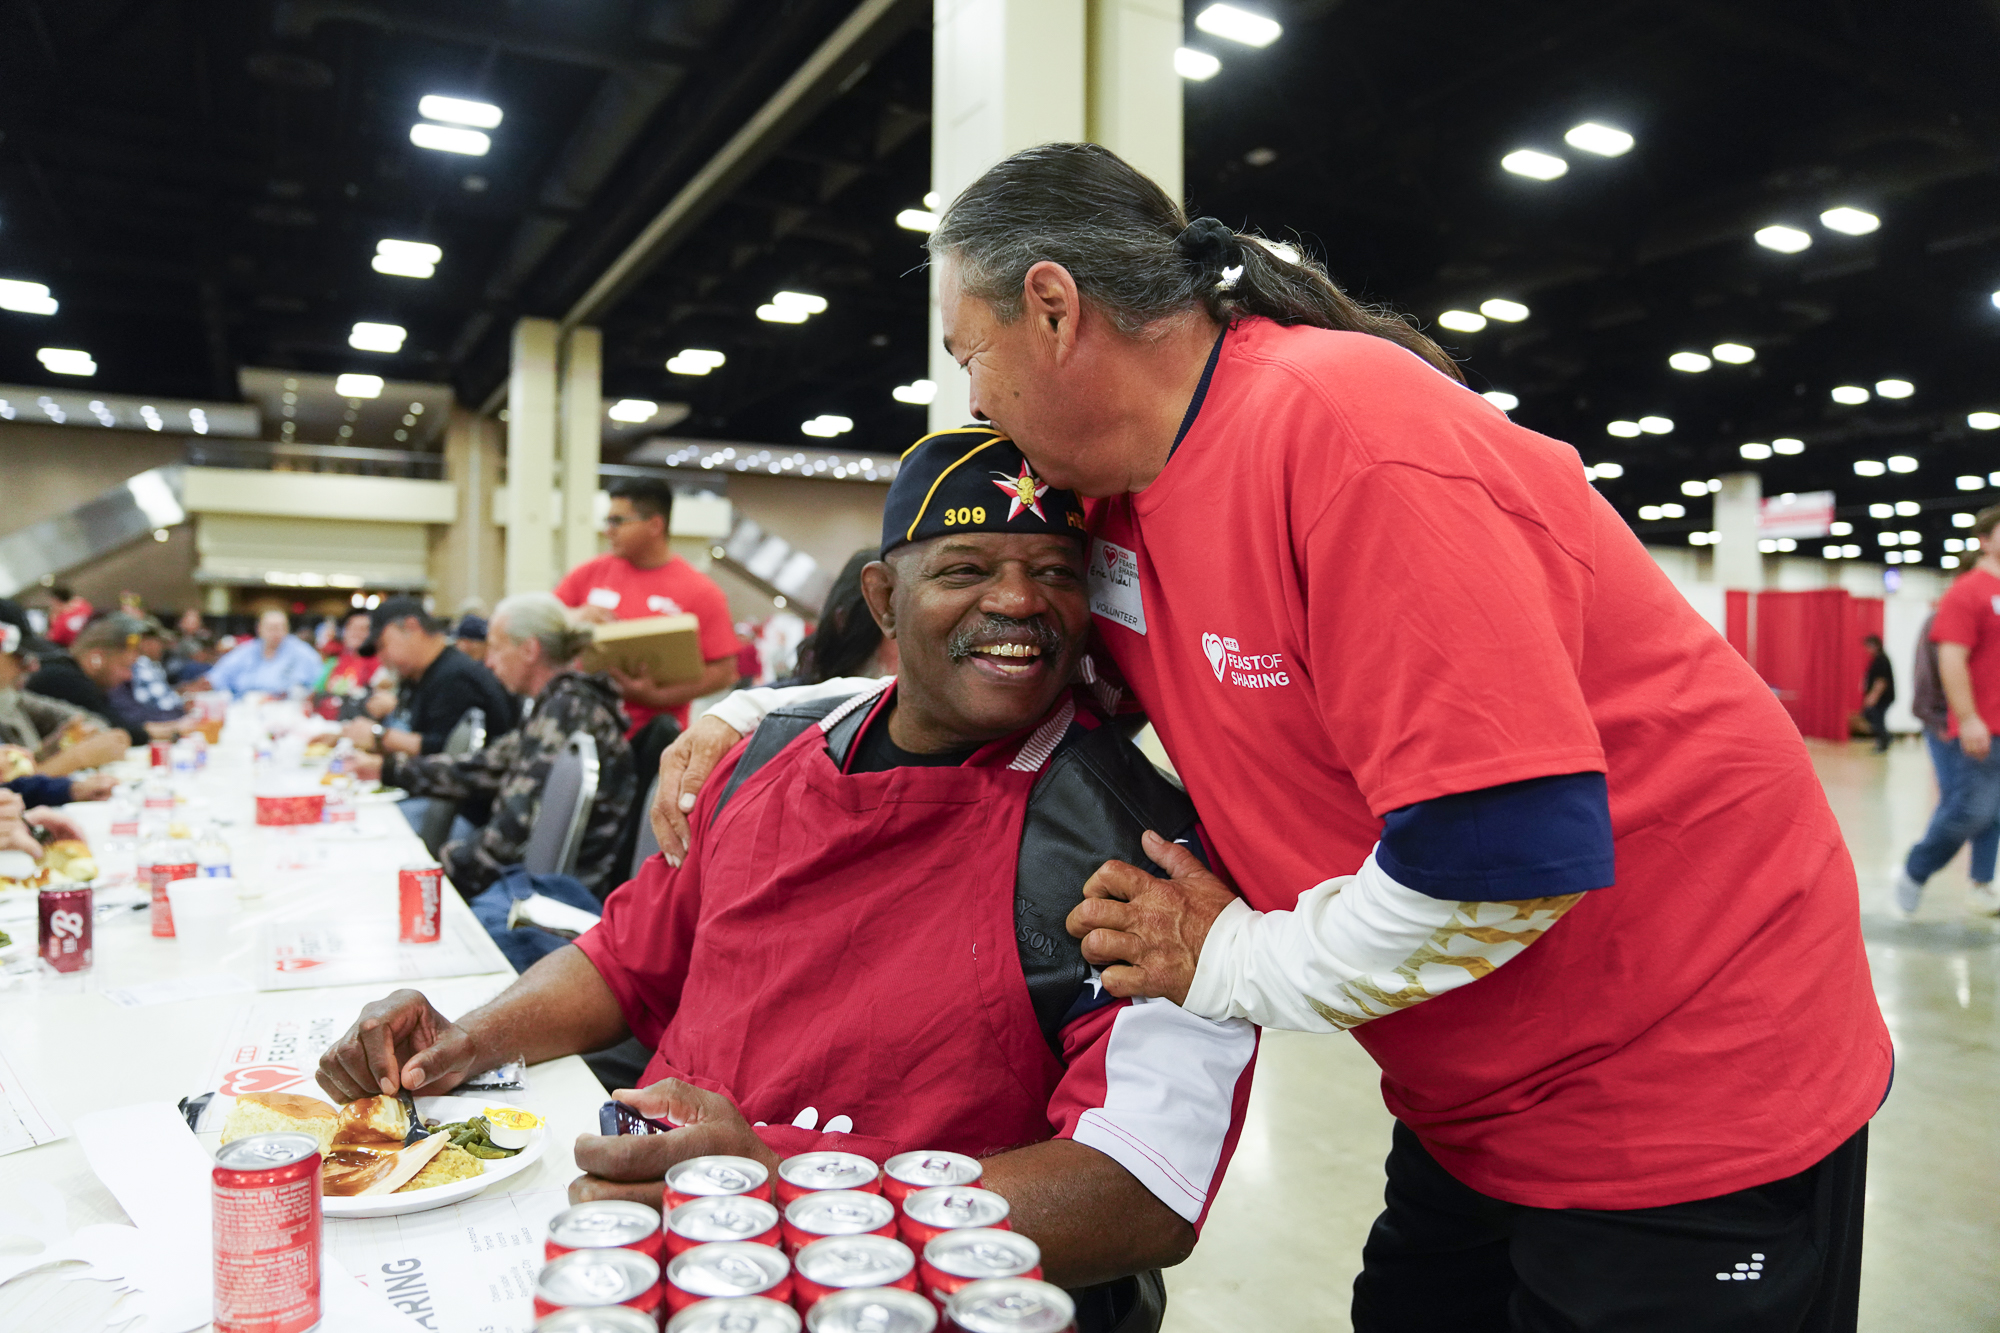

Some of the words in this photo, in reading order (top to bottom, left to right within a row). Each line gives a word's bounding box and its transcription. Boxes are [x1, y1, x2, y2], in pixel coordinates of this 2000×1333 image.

[943, 506, 986, 527] 309
[1118, 558, 1136, 570] FEAST
[1089, 565, 1107, 579] Eric
[1109, 570, 1132, 588] Vidal
[1095, 601, 1138, 626] VOLUNTEER
[1231, 671, 1290, 689] SHARING
[1016, 896, 1041, 917] Y-
[267, 1033, 298, 1062] FEAST
[381, 1258, 439, 1333] ARING
